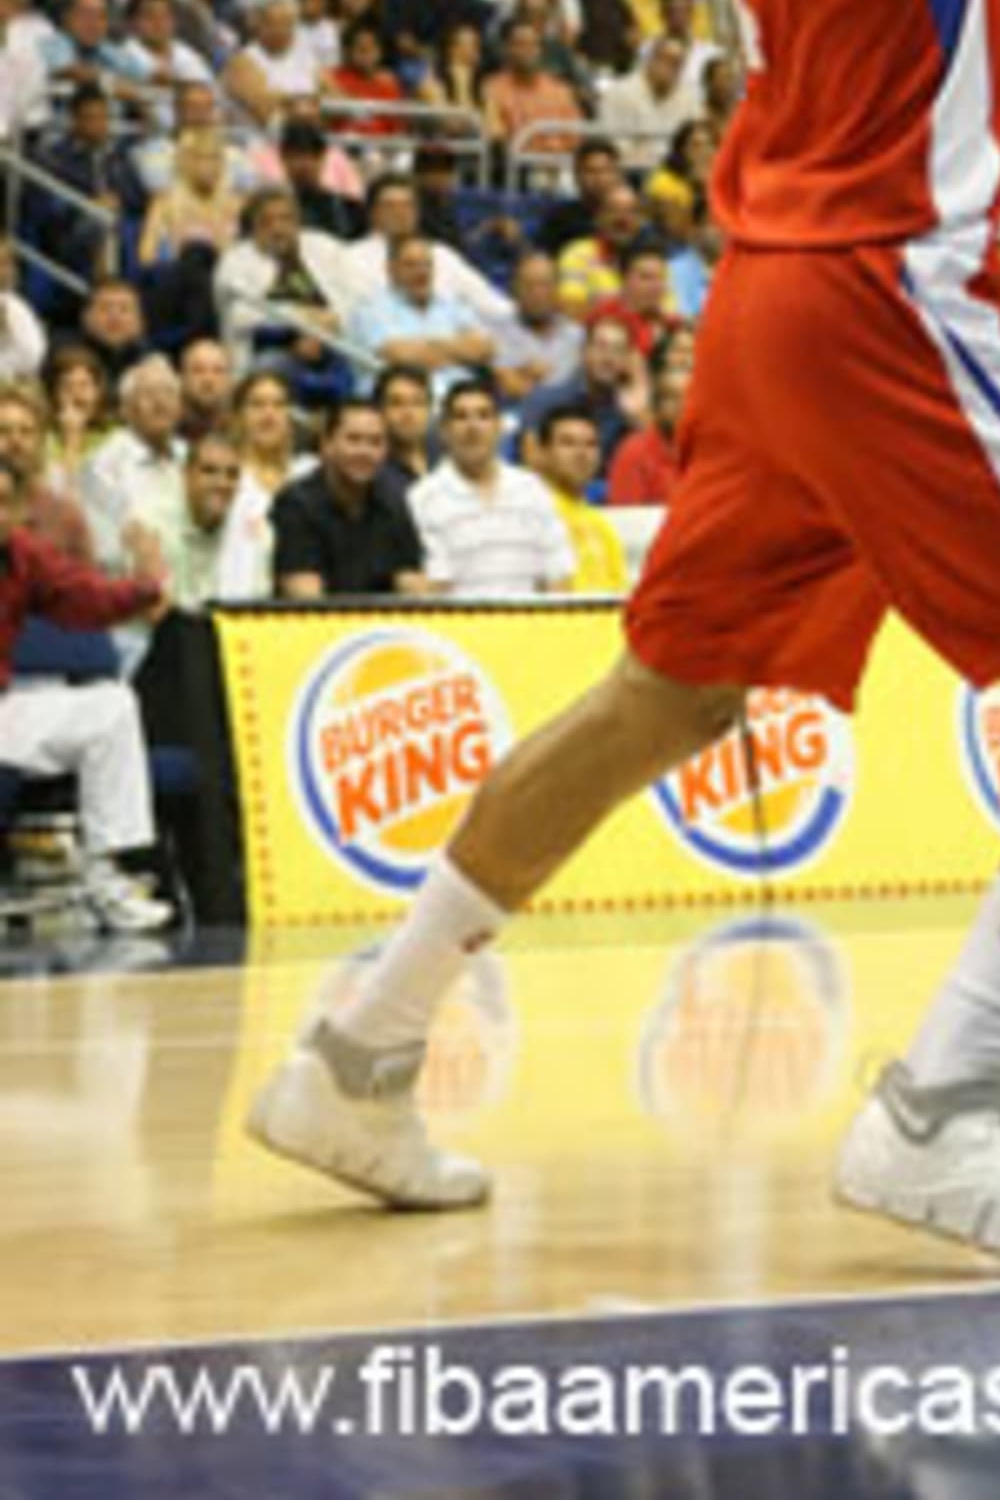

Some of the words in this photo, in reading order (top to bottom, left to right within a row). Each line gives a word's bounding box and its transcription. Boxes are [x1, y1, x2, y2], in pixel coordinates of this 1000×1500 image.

[318, 676, 482, 773] BURGER
[335, 719, 493, 839] KING
[678, 711, 828, 821] KING
